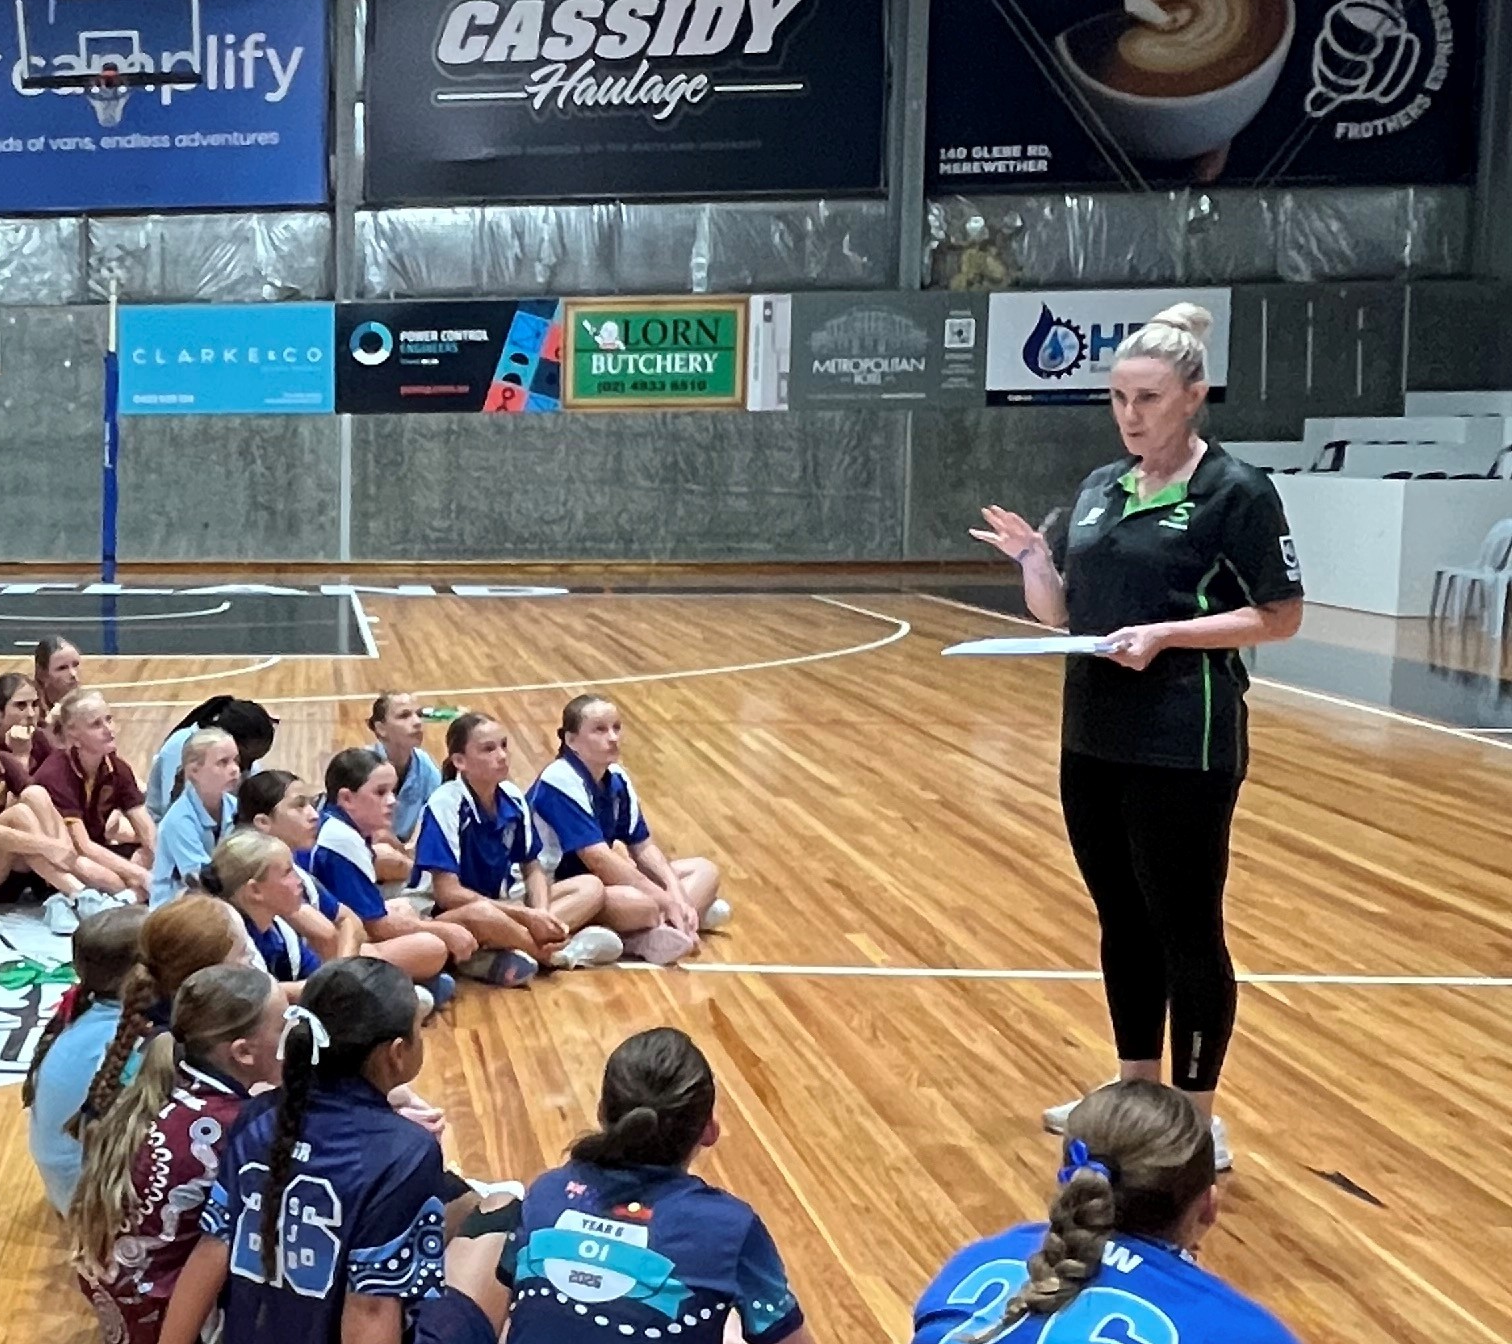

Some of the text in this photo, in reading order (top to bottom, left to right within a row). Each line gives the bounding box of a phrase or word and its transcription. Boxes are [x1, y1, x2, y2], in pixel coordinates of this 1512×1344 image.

[524, 59, 708, 120] Haulage
[26, 135, 46, 152] of
[49, 136, 96, 153] vans,
[100, 133, 170, 151] endless
[174, 130, 280, 149] adventures
[939, 159, 1048, 174] MEREWETHER
[622, 318, 721, 347] LORN
[591, 353, 719, 374] BUTCHERY
